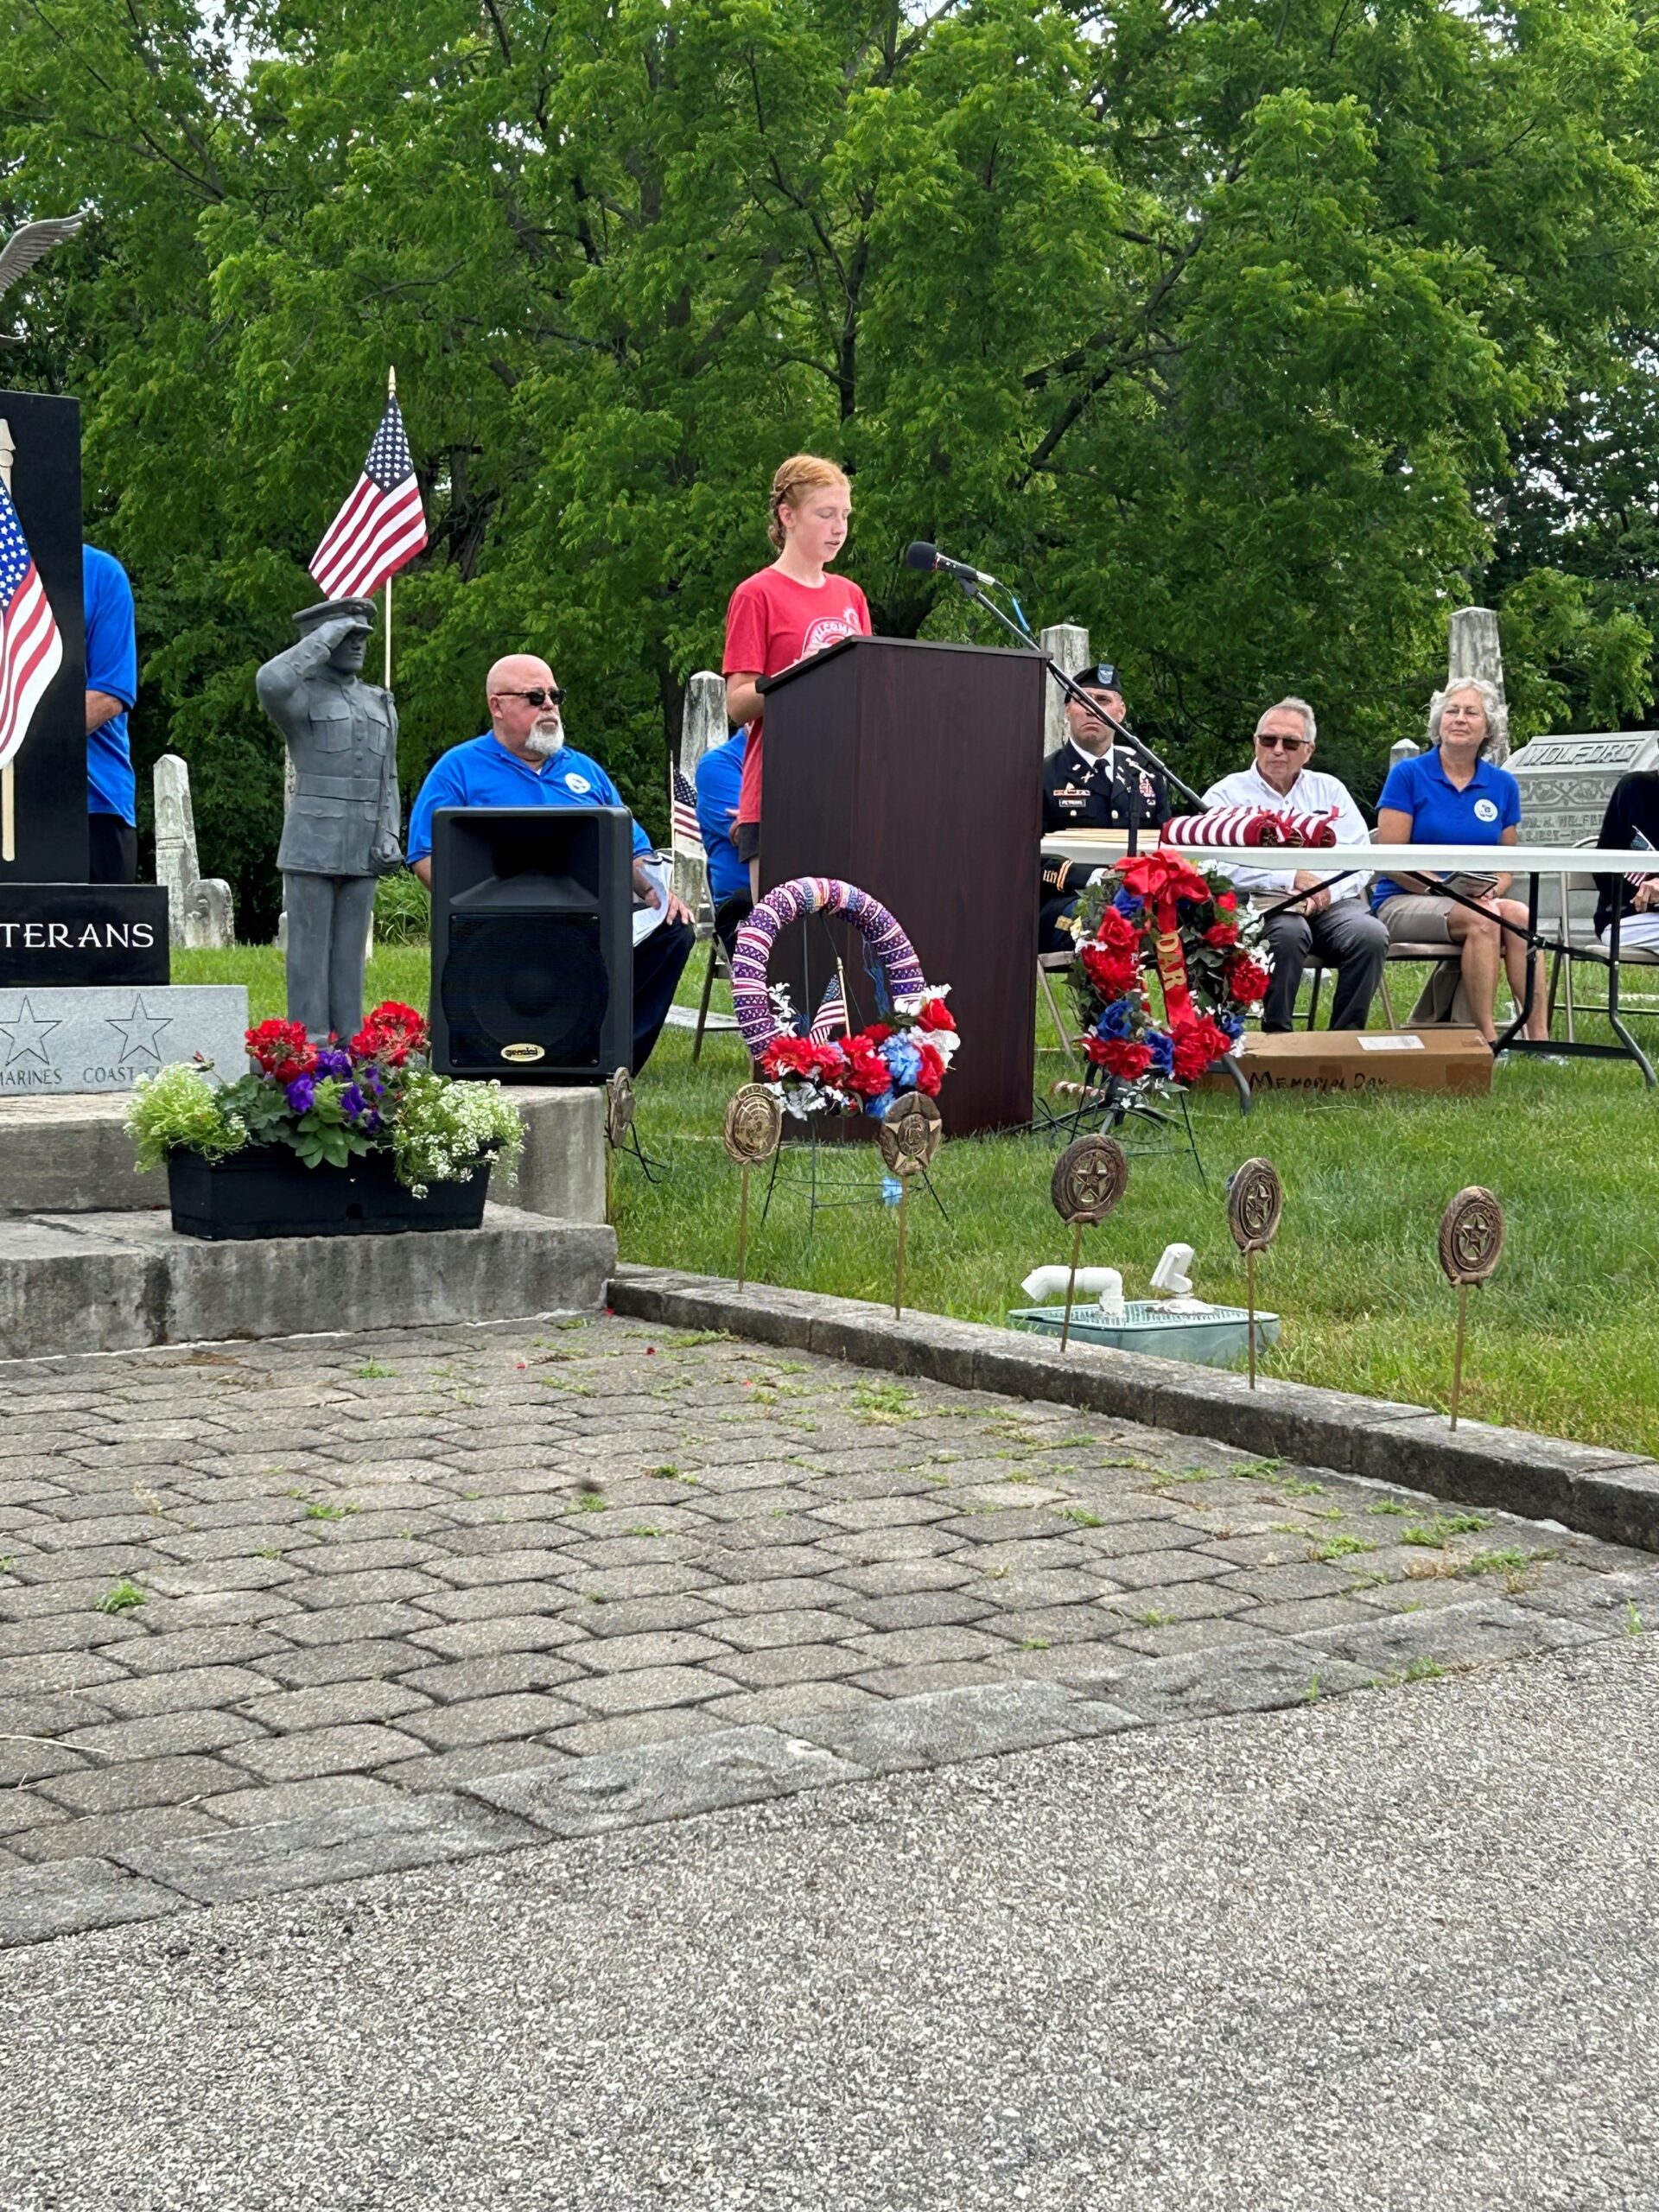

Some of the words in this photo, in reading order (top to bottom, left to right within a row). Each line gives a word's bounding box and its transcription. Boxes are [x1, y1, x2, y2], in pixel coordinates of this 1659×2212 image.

[1516, 742, 1638, 767] WOLFORD
[0, 923, 154, 948] TERANS
[0, 1068, 62, 1085] ARINES
[83, 1066, 134, 1083] COAST
